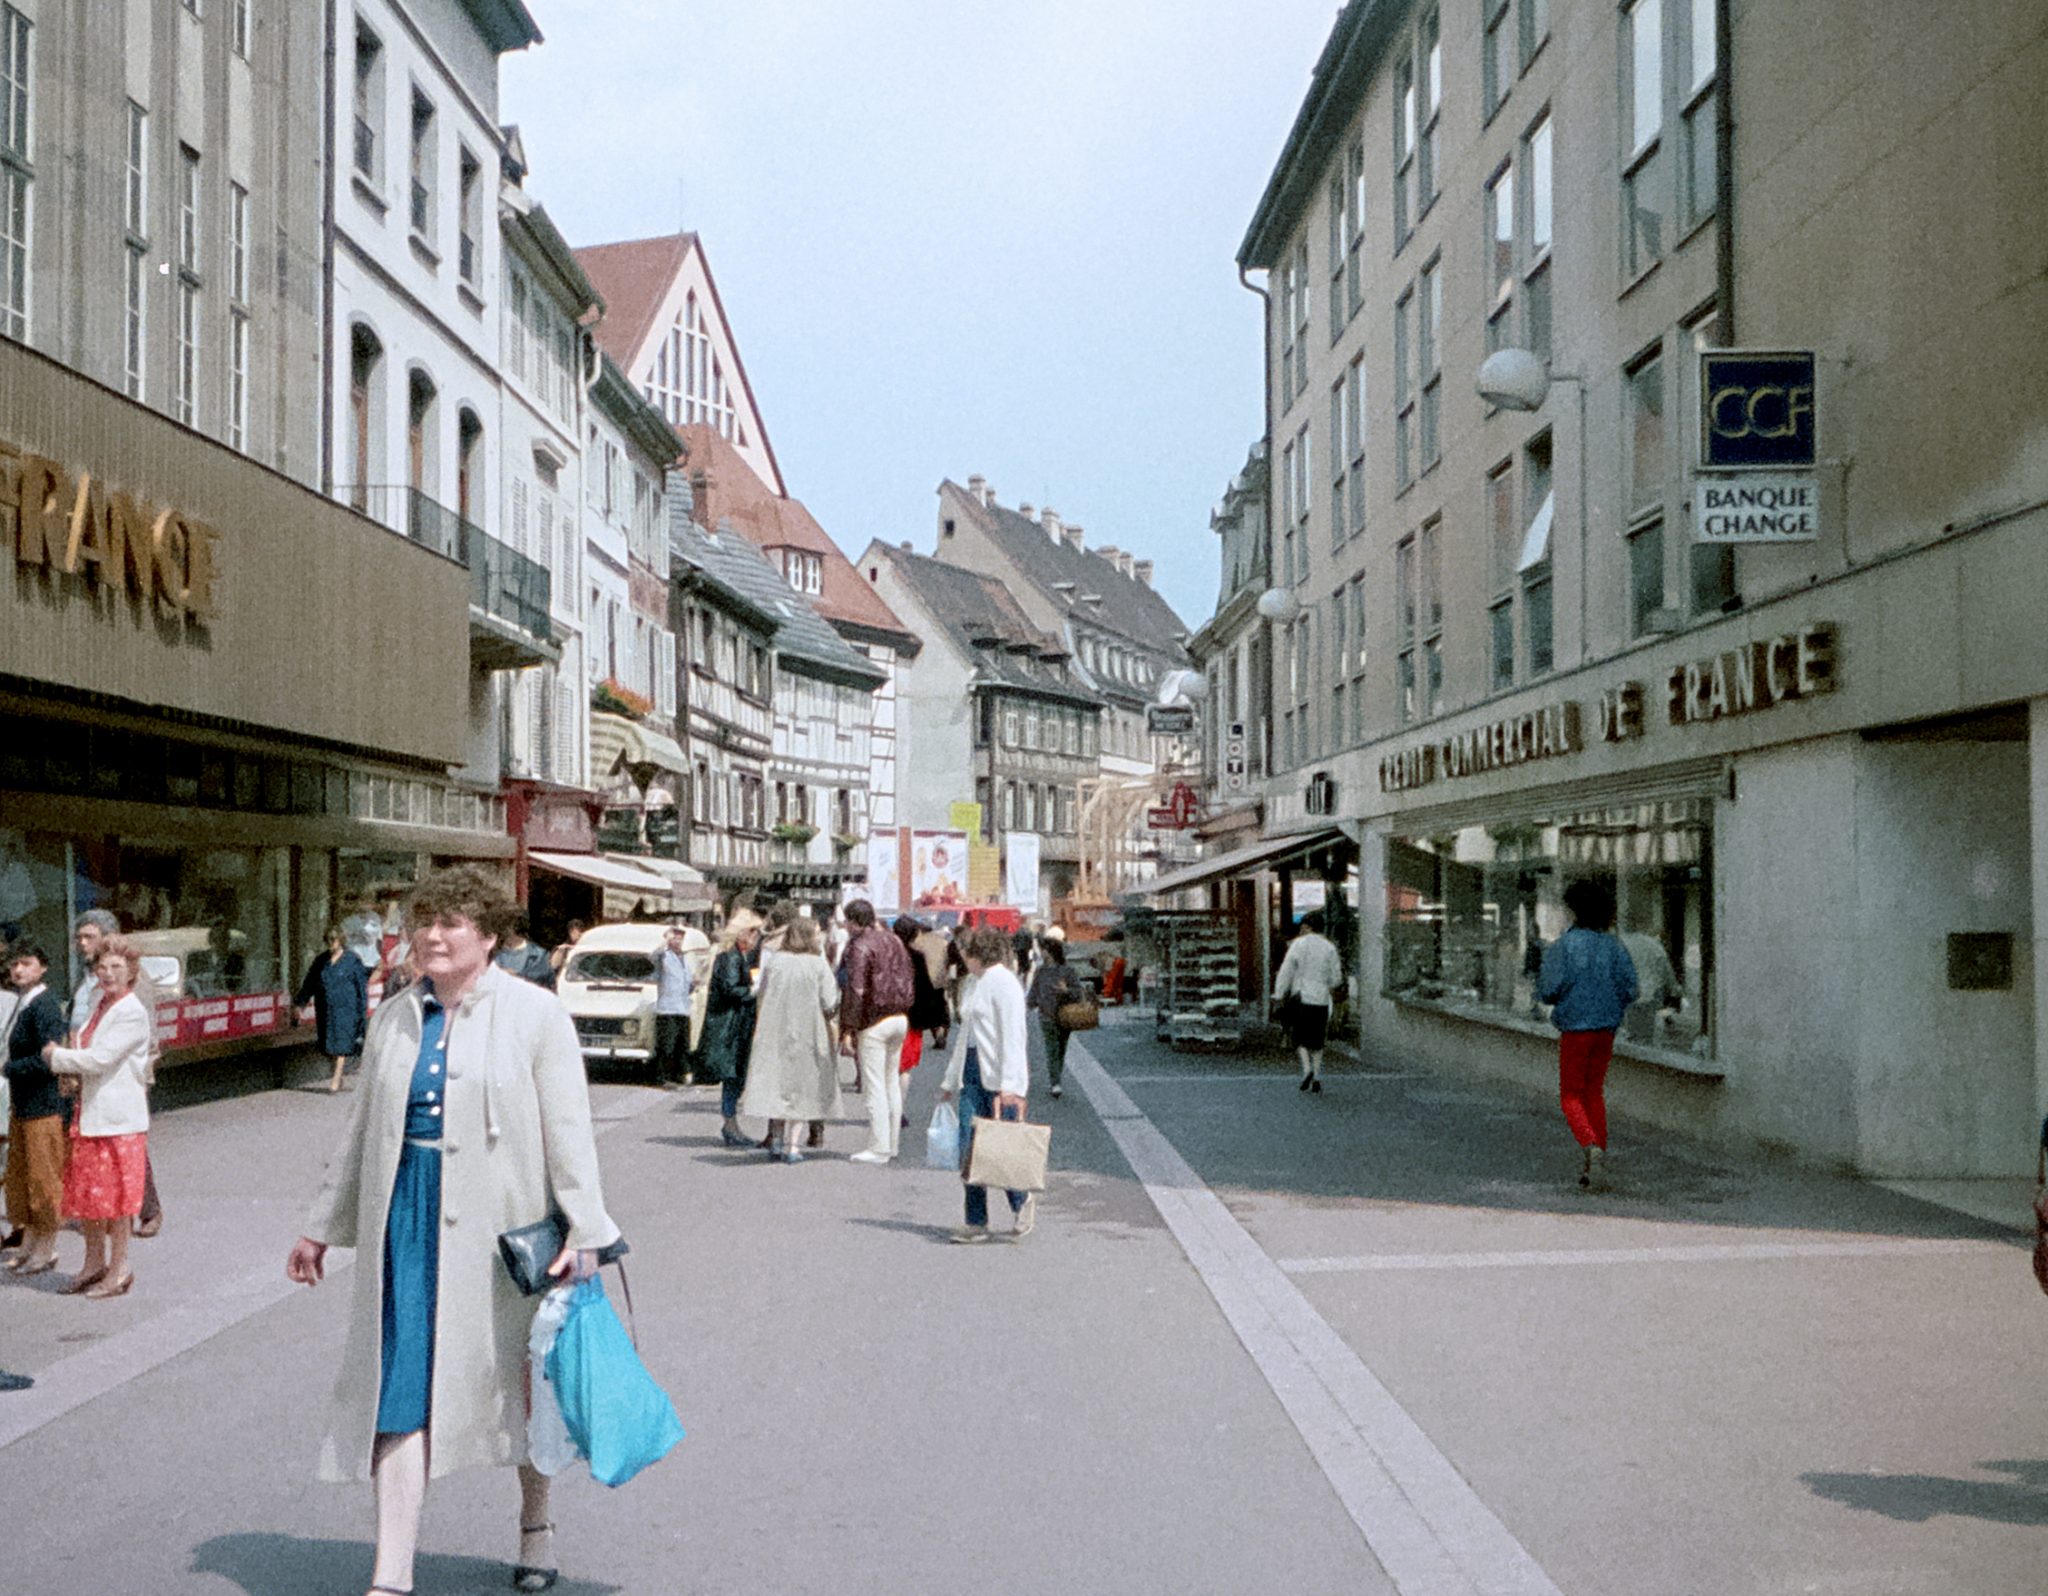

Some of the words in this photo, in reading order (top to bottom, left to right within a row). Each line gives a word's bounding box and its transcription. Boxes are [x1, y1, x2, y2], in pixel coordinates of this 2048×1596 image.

[1710, 385, 1814, 439] CCF
[1705, 487, 1813, 511] BANQUE
[1705, 513, 1812, 536] CHANGE
[1438, 700, 1583, 779] COMMERCIAL
[1600, 680, 1647, 744] DE
[1667, 620, 1843, 727] FRANCE
